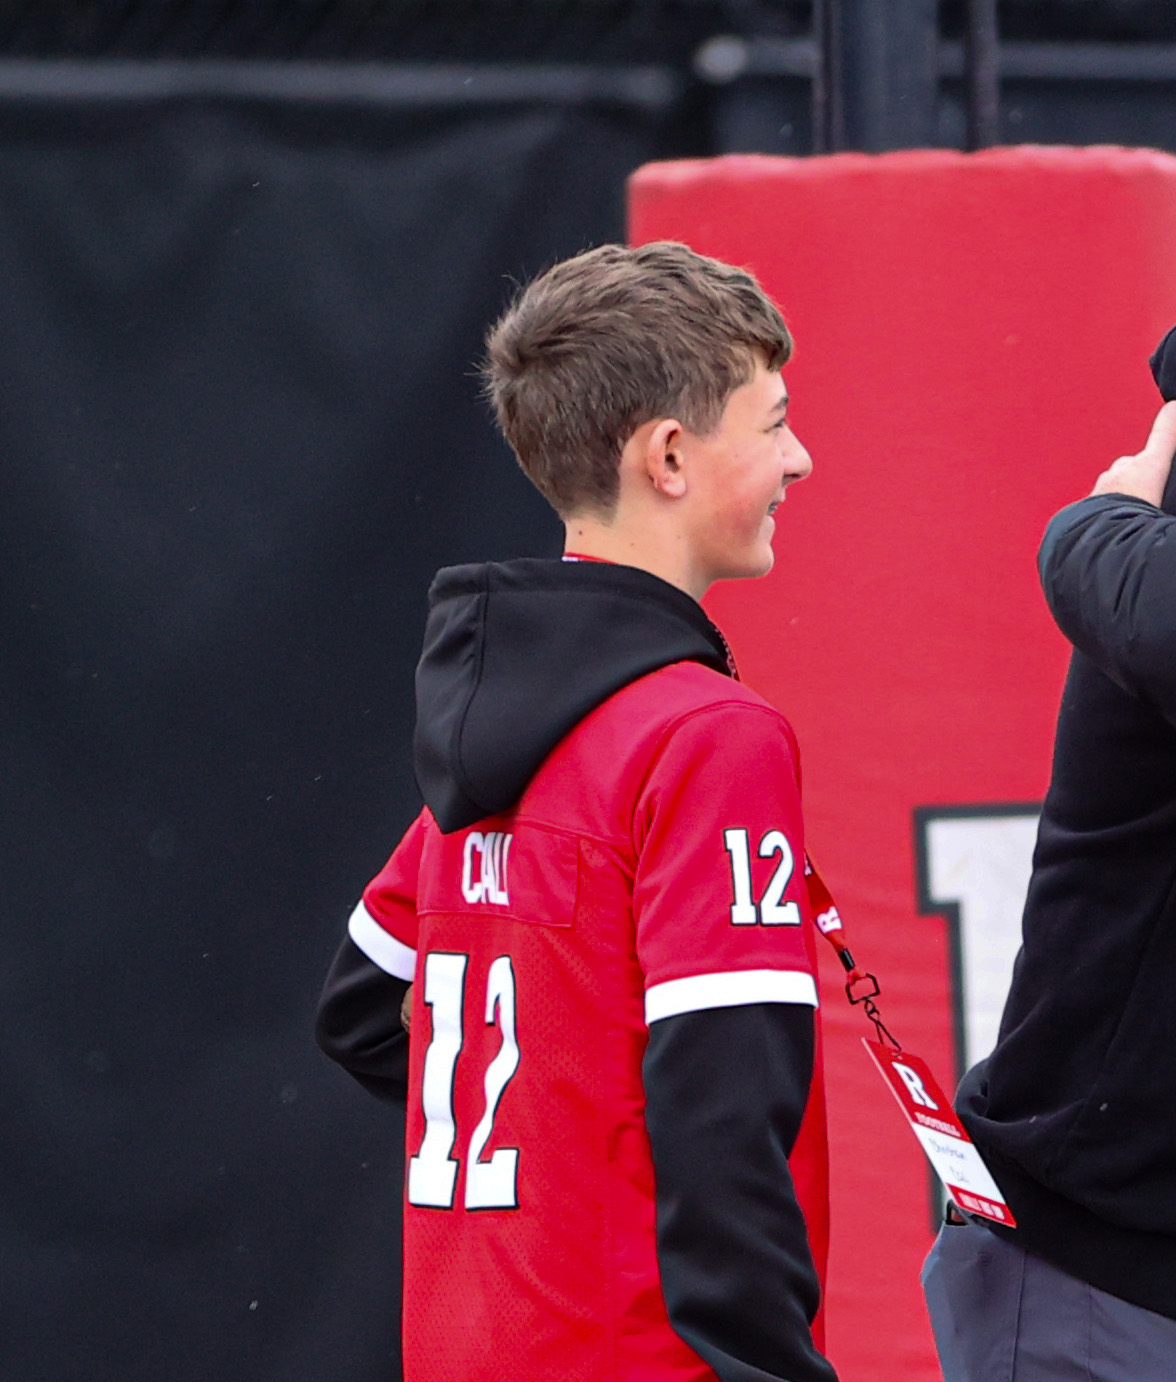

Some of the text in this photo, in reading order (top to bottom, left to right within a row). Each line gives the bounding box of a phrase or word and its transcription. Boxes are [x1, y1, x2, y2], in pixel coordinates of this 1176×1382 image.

[724, 827, 802, 928] 12
[816, 905, 844, 935] R
[408, 952, 520, 1210] 12
[891, 1060, 940, 1112] R
